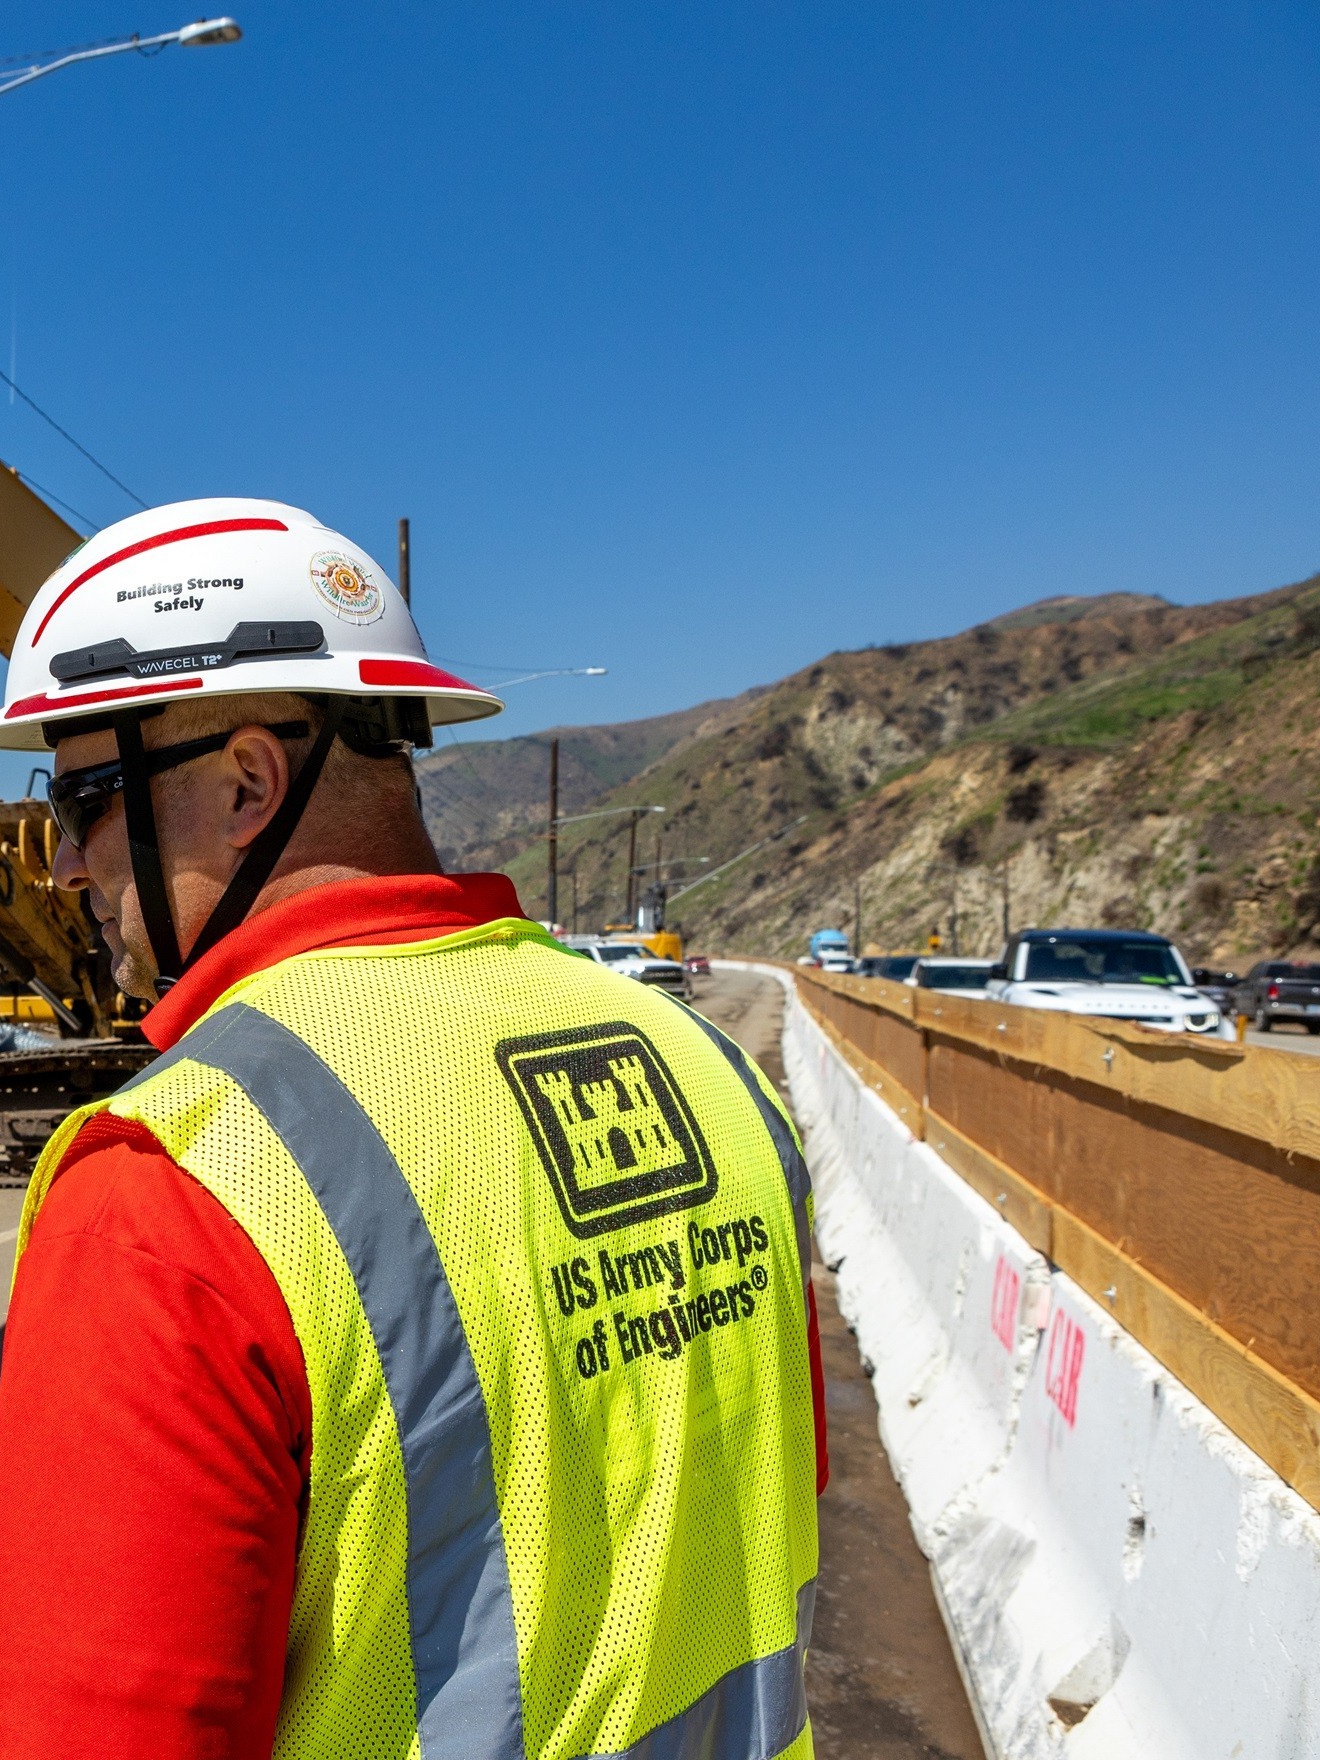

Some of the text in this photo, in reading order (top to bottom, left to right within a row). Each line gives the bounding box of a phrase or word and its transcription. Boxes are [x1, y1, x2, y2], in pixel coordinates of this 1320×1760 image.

[116, 577, 244, 603] Building Strong
[154, 596, 205, 613] Safely
[137, 657, 199, 674] WAVECEL
[550, 1214, 770, 1317] US Army Corps
[575, 1318, 611, 1380] of
